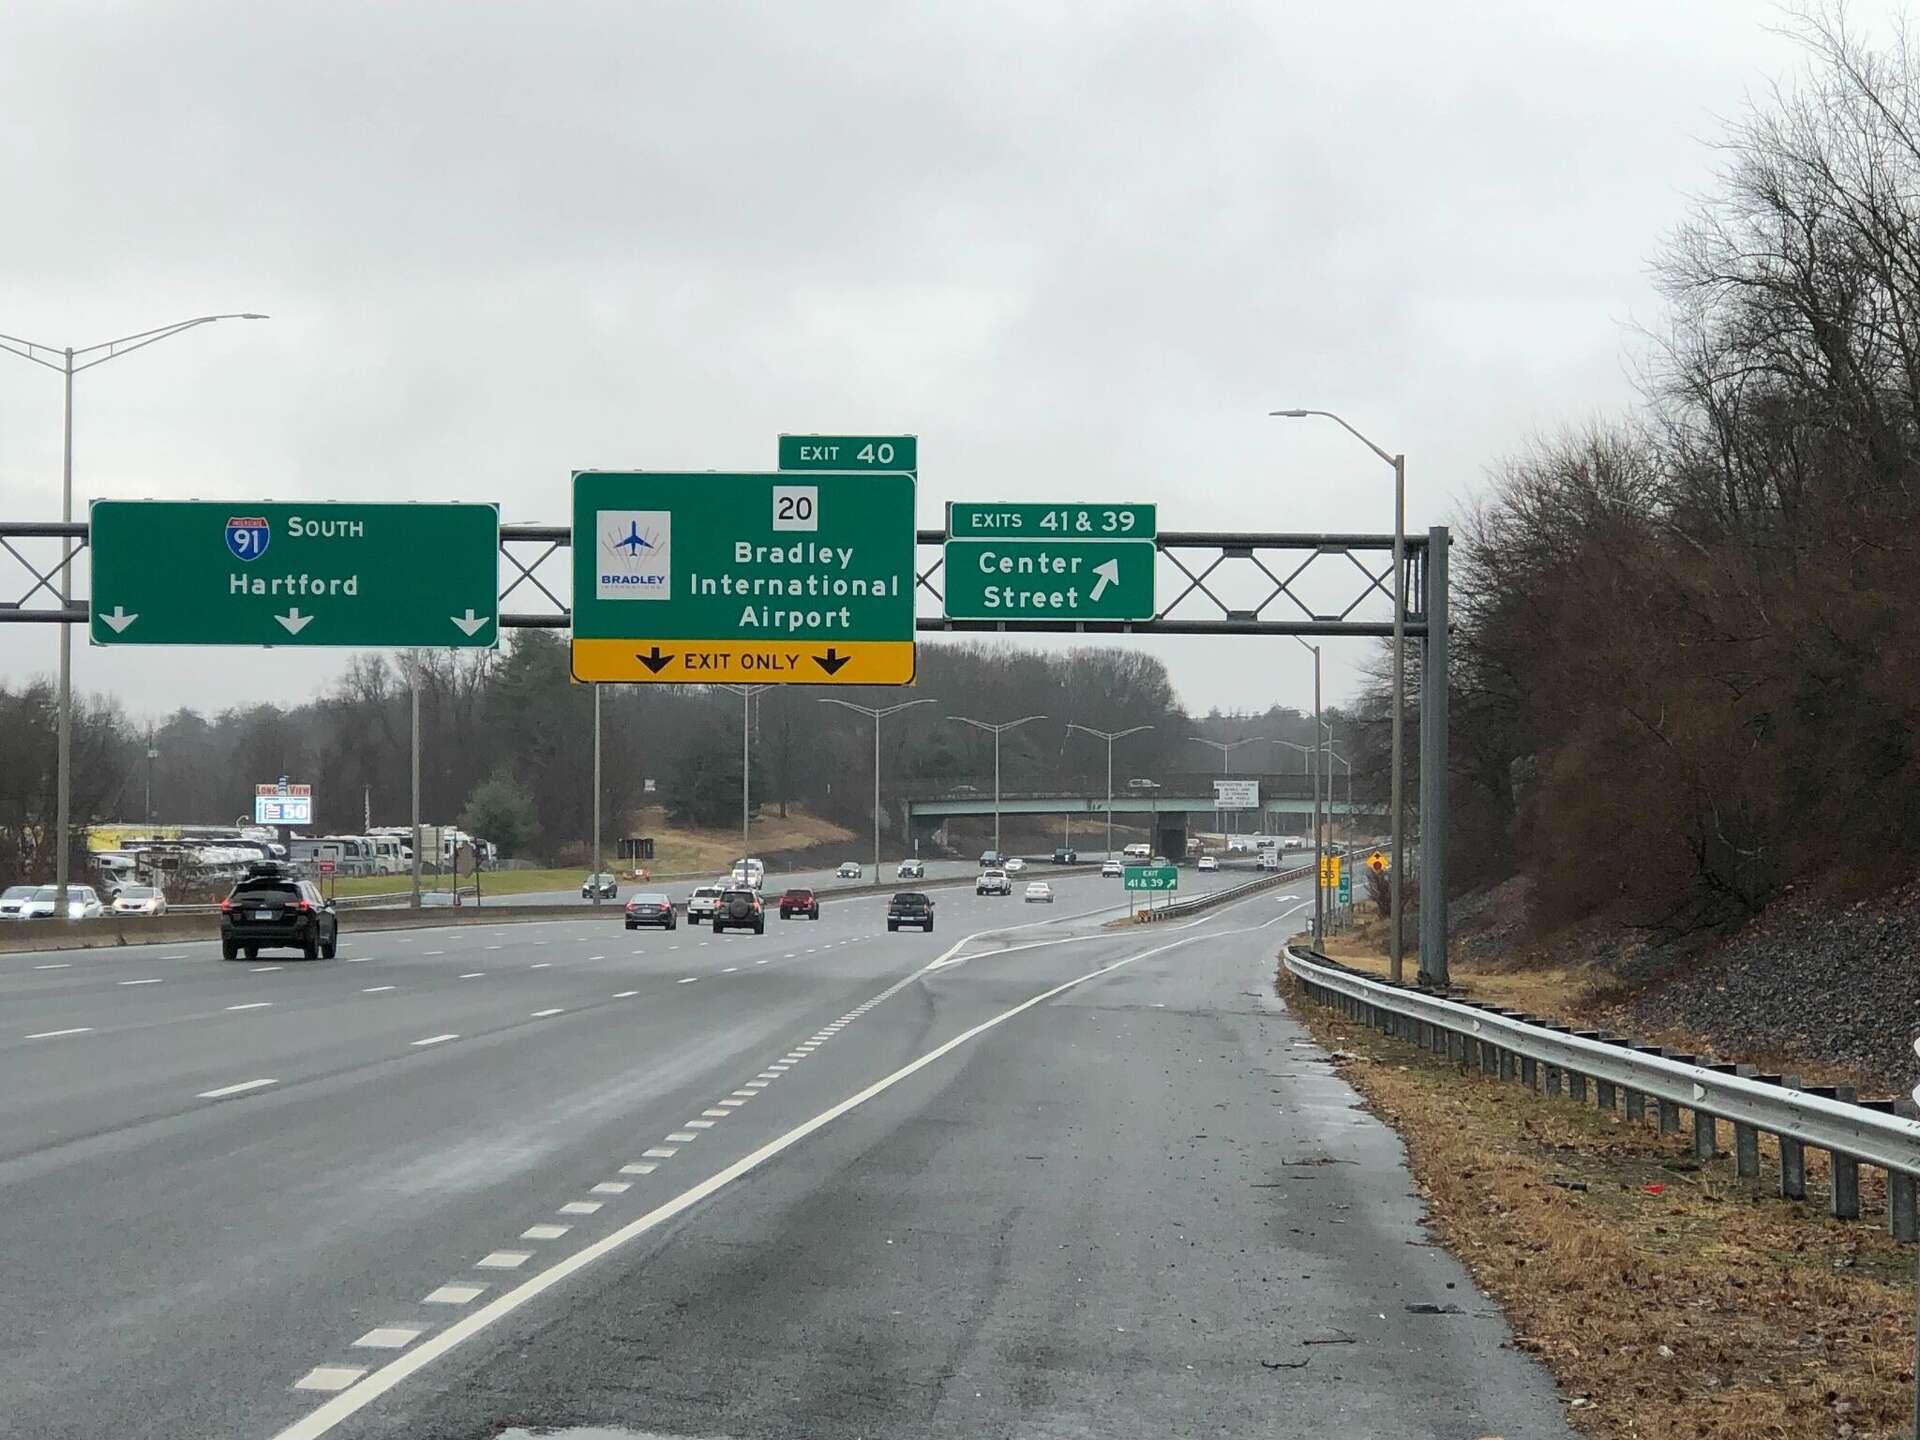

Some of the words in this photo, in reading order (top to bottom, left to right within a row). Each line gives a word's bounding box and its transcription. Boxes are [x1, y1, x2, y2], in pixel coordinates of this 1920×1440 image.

[799, 446, 840, 461] EXIT
[856, 443, 896, 464] 40
[778, 497, 812, 520] 20
[287, 516, 364, 537] SOUTH
[971, 513, 1023, 528] EXITS
[1039, 511, 1068, 531] 41
[1075, 511, 1093, 532] &
[1101, 511, 1136, 532] 39
[233, 529, 259, 554] 91
[735, 541, 854, 570] Bradley
[979, 551, 1083, 574] Center
[229, 573, 358, 596] Hartford
[601, 575, 665, 584] BRADLEY
[691, 573, 899, 597] International
[983, 586, 1079, 608] Street
[738, 605, 851, 633] Airport
[684, 653, 732, 670] EXIT
[740, 653, 800, 670] ONLY
[1127, 878, 1138, 888] 41
[1140, 878, 1147, 888] &
[1150, 878, 1164, 888] 39
